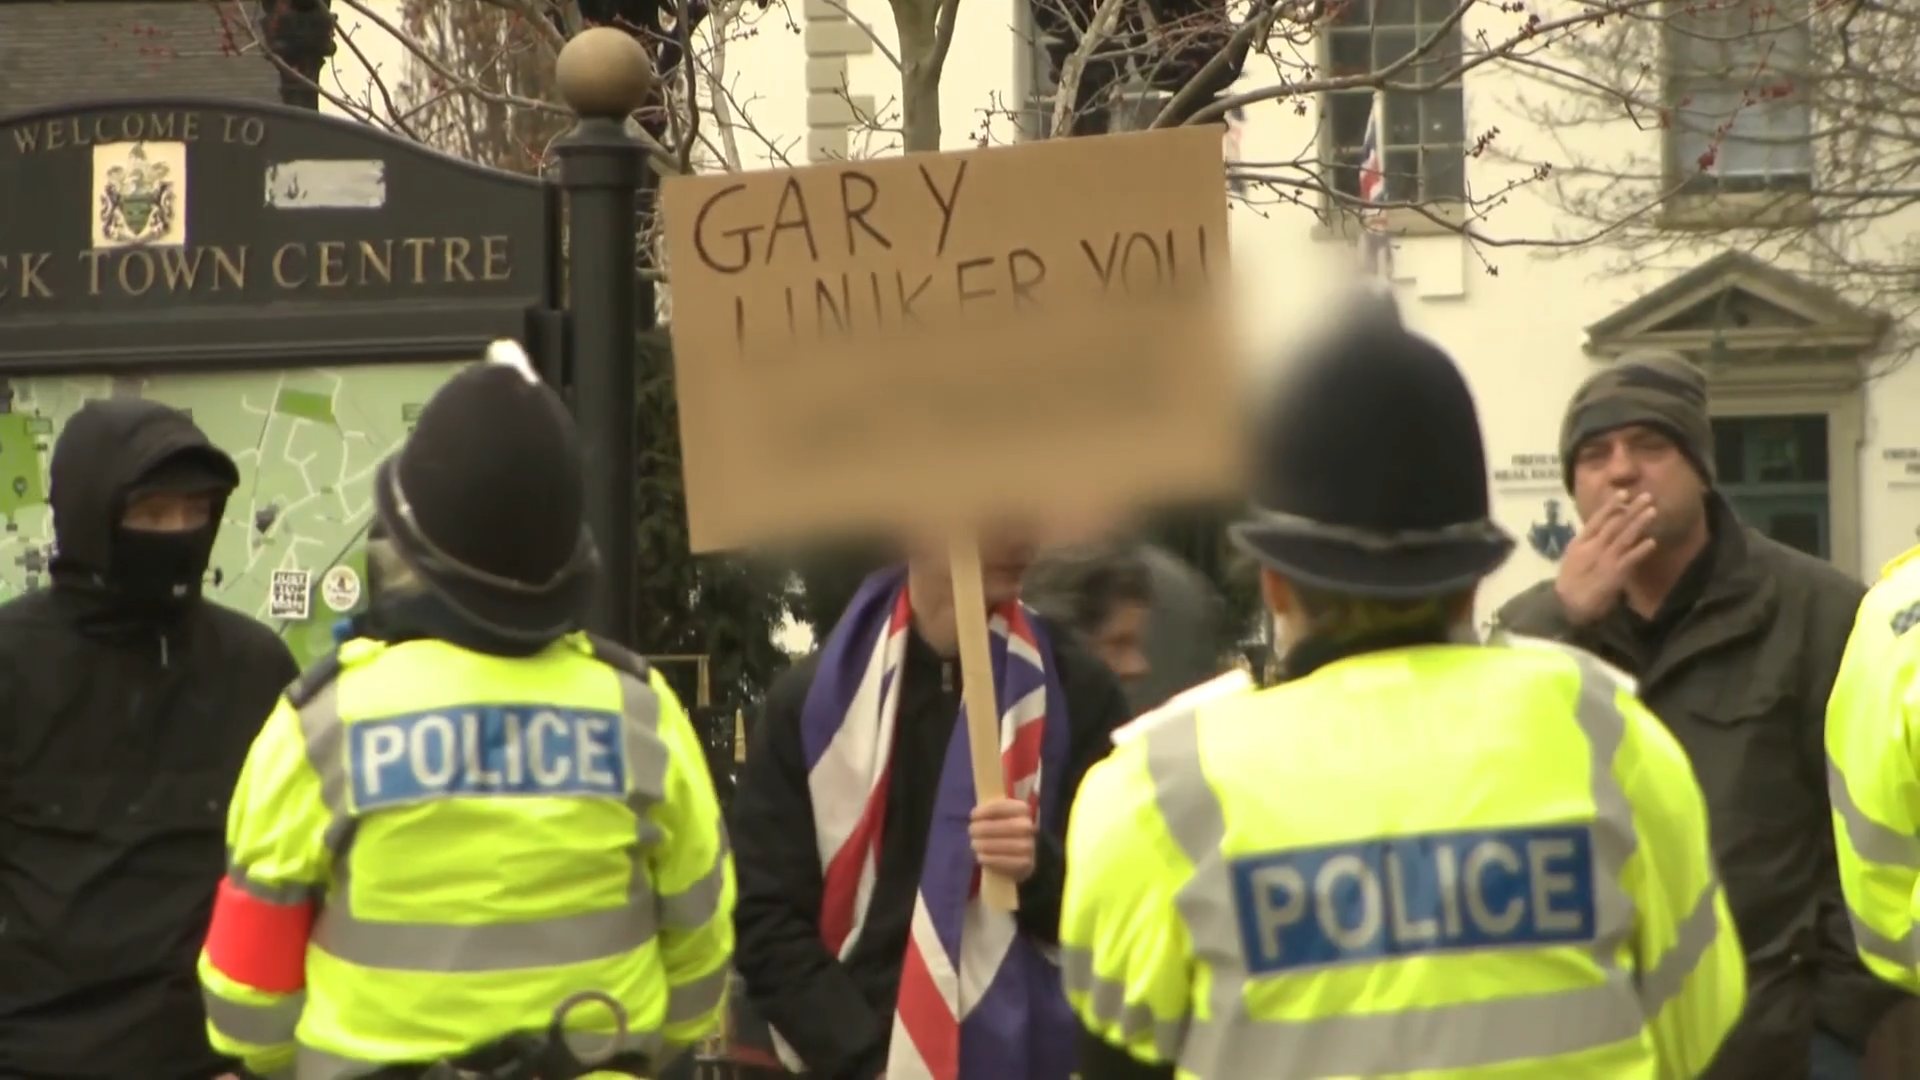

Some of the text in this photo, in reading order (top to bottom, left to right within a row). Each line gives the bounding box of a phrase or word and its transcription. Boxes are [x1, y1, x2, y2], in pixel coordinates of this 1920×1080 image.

[13, 111, 266, 154] WELCOME TO
[692, 160, 968, 275] GARY
[0, 234, 513, 299] K TOWN CENTRE
[361, 711, 614, 797] POLICE
[1249, 838, 1583, 961] POLICE
